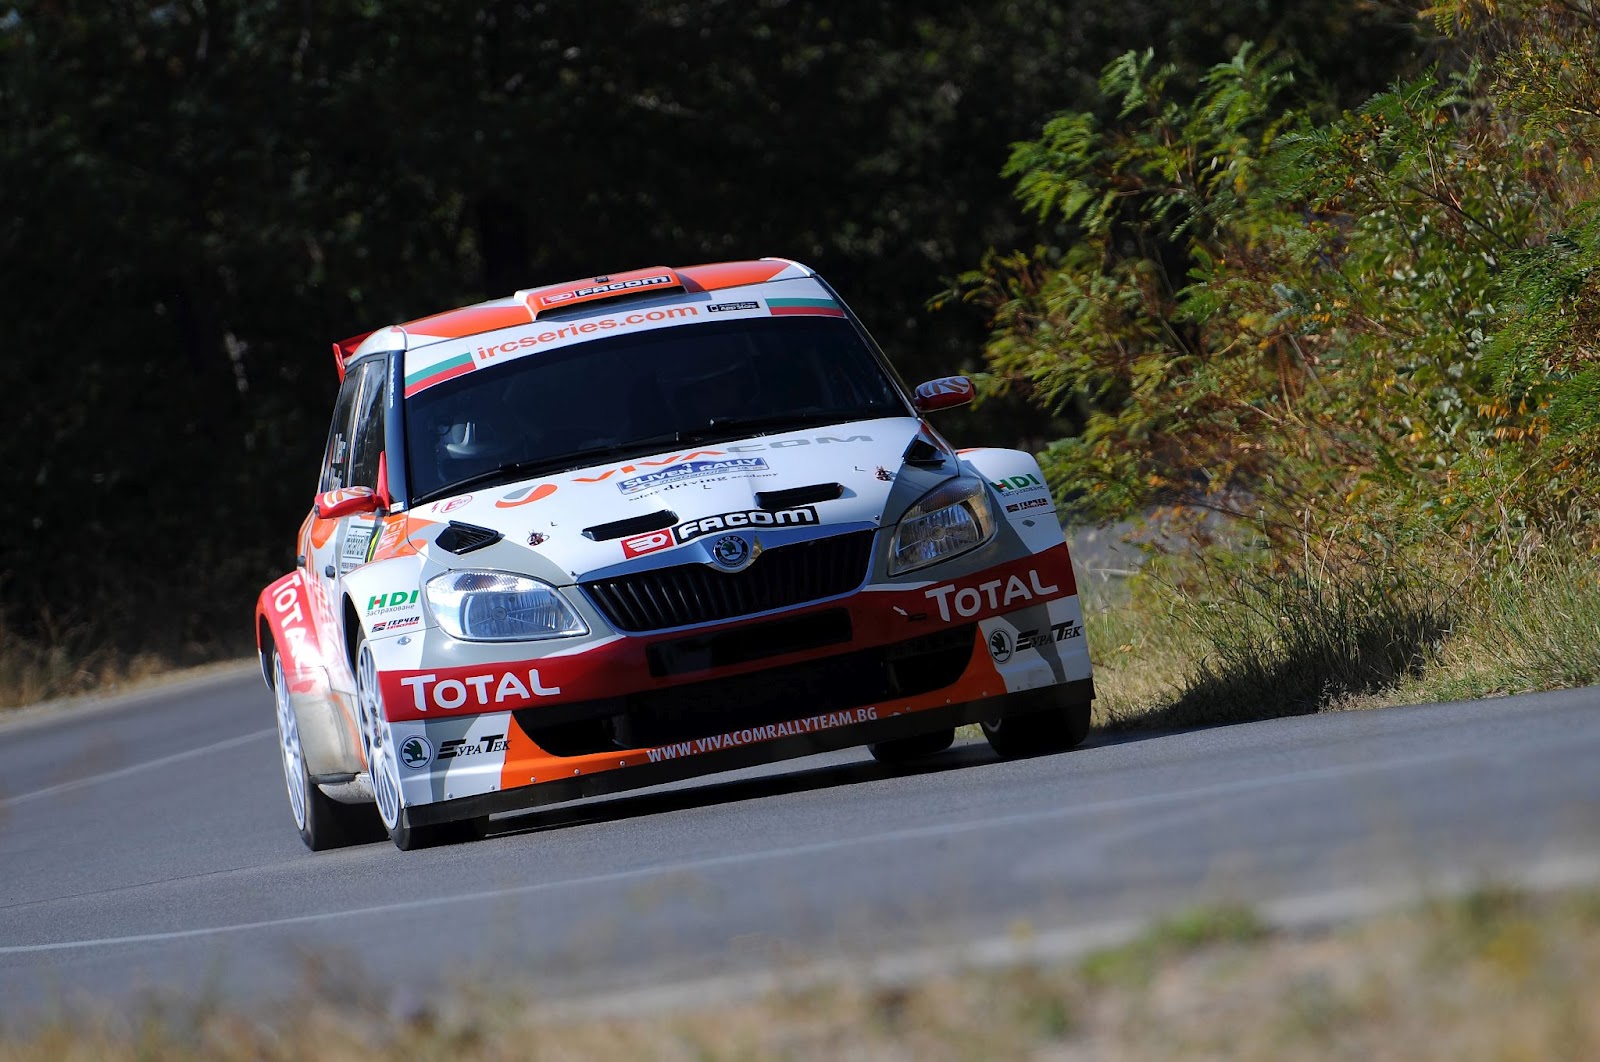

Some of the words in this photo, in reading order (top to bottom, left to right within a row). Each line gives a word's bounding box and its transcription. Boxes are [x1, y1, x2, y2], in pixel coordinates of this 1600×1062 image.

[578, 276, 669, 297] FACOM
[477, 303, 698, 360] ircseries.com
[571, 435, 874, 482] VIVACOM
[623, 467, 693, 489] SLIVEN
[699, 457, 758, 472] RALLY
[664, 476, 728, 492] driving
[988, 473, 1041, 493] HDI
[678, 508, 814, 540] FACOM
[367, 590, 419, 611] HDI
[925, 569, 1059, 622] TOTAL
[400, 668, 561, 712] TOTAL
[646, 706, 878, 764] WWW.VIVACOMRALLYTEAM.BG
